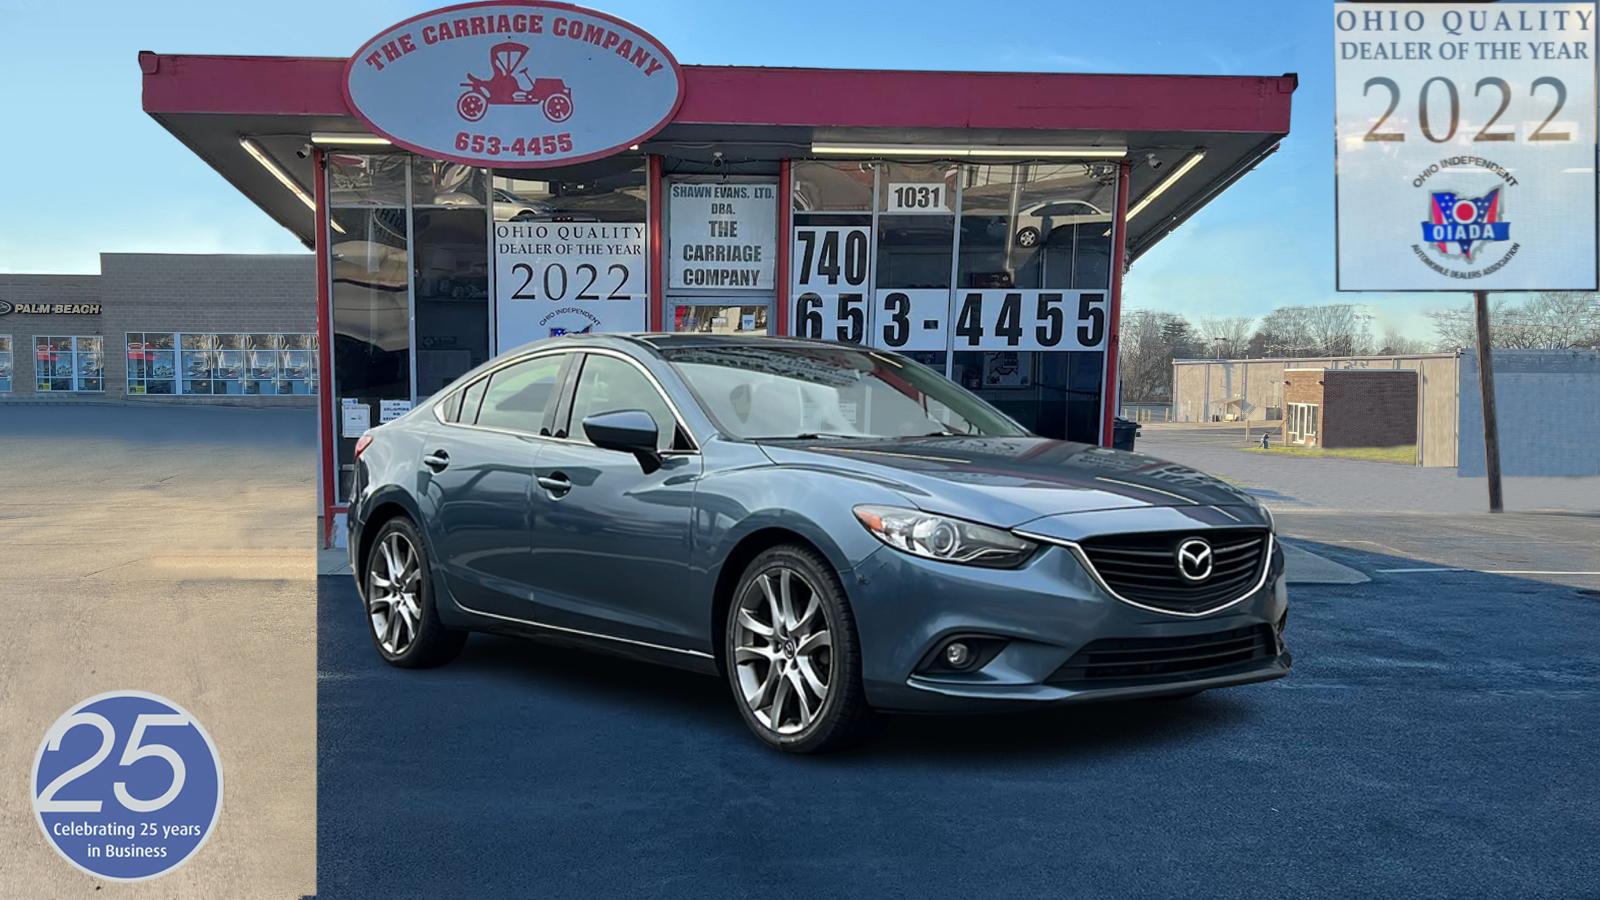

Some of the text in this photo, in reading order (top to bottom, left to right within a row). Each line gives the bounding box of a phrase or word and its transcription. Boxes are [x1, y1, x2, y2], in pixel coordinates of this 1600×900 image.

[1336, 10, 1593, 35] OHIO QUALITY
[366, 14, 663, 77] THE CARRIAGE COMPANY
[1340, 42, 1589, 60] DEALER OF THE YEAR
[1363, 76, 1571, 143] 2022
[455, 132, 573, 156] 653-4455
[1412, 156, 1519, 188] OHIO INDEPENDENT
[672, 186, 712, 198] SHAWN
[755, 187, 775, 199] LTD.
[895, 187, 940, 208] 1031
[711, 203, 736, 214] DBA.
[497, 226, 644, 241] OHIO QUALITY
[708, 221, 737, 237] THE
[1432, 224, 1495, 240] OIADA
[500, 243, 641, 255] DEALER OF THE YEAR
[683, 244, 762, 262] CARRIAGE
[797, 230, 868, 286] 740
[1411, 242, 1521, 280] AUTOMOBILE DEALERS ASSOCIATION
[511, 262, 631, 301] 2022
[683, 268, 761, 286] COMPANY
[14, 303, 100, 314] PALM BEACH
[539, 307, 601, 327] OHIO INDEPENDENT
